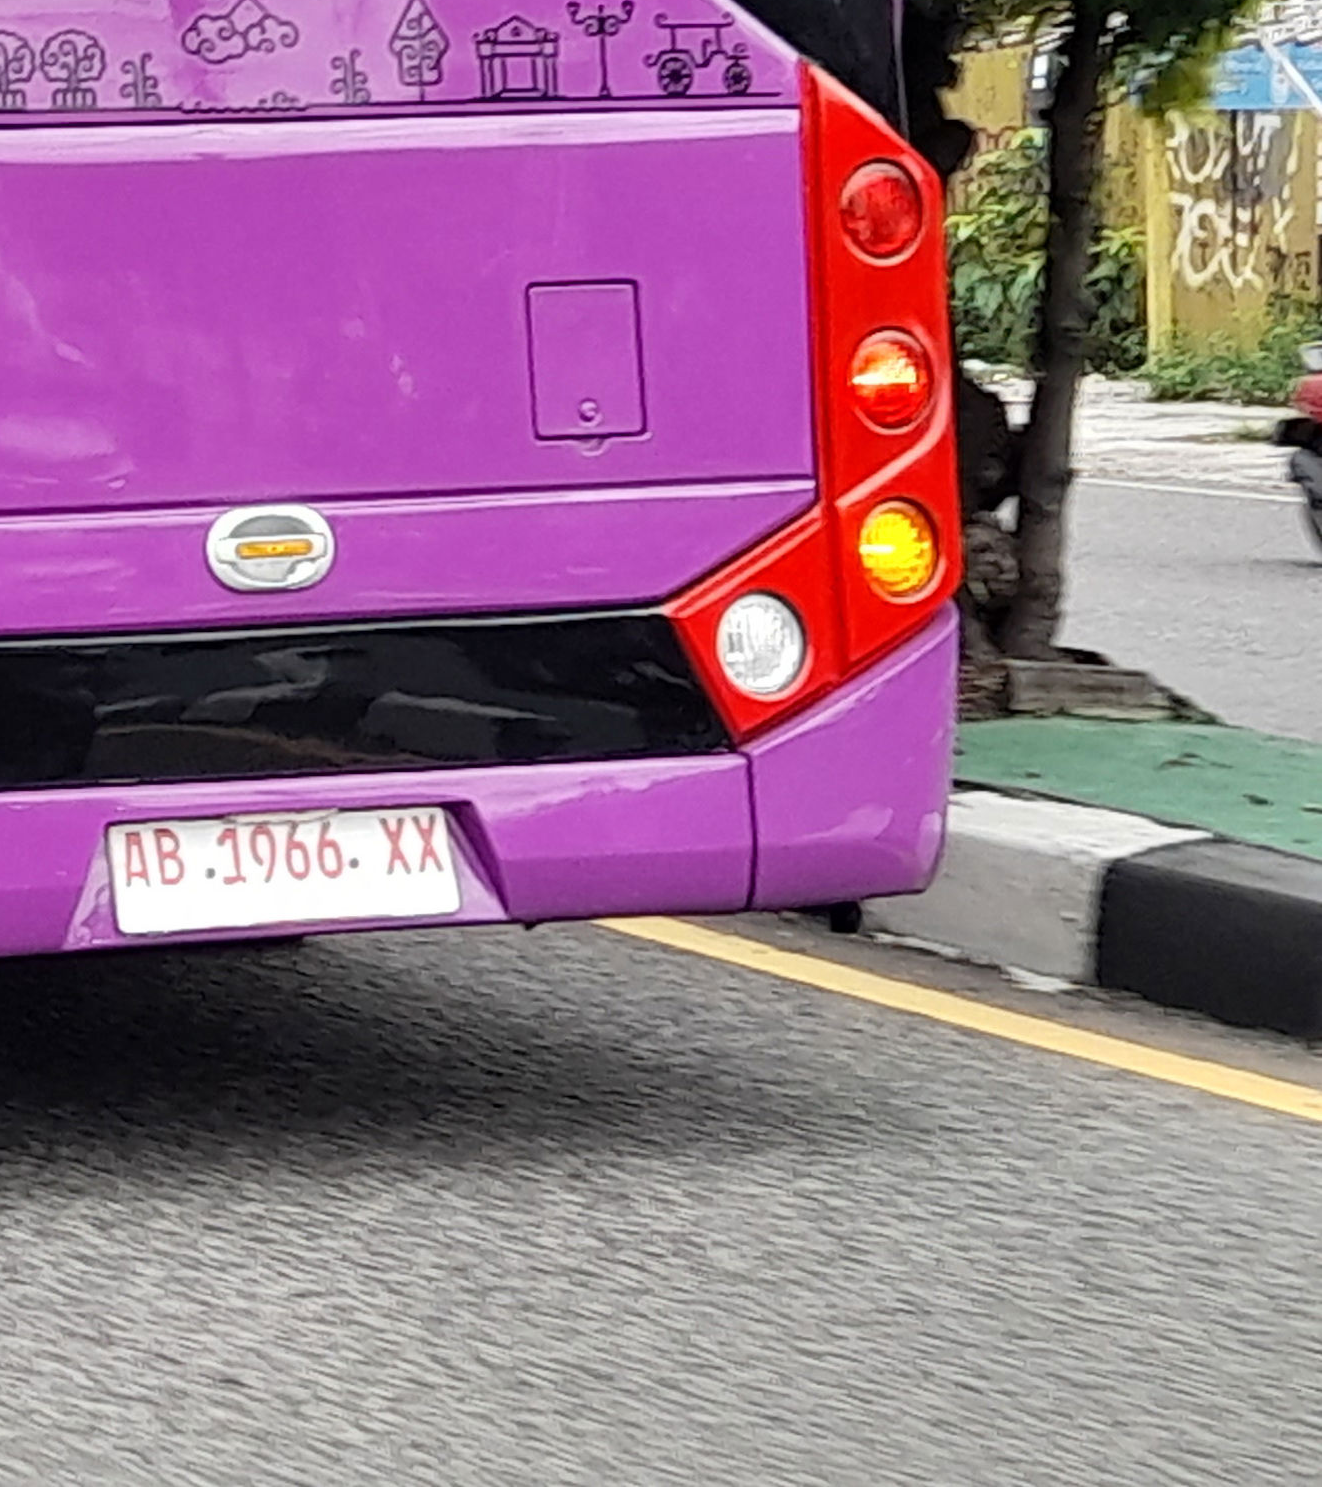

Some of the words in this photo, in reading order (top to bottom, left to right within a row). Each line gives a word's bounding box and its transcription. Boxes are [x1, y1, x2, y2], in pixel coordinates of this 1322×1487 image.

[123, 826, 187, 888] AB
[216, 819, 345, 886] 1966
[378, 812, 445, 876] XX
